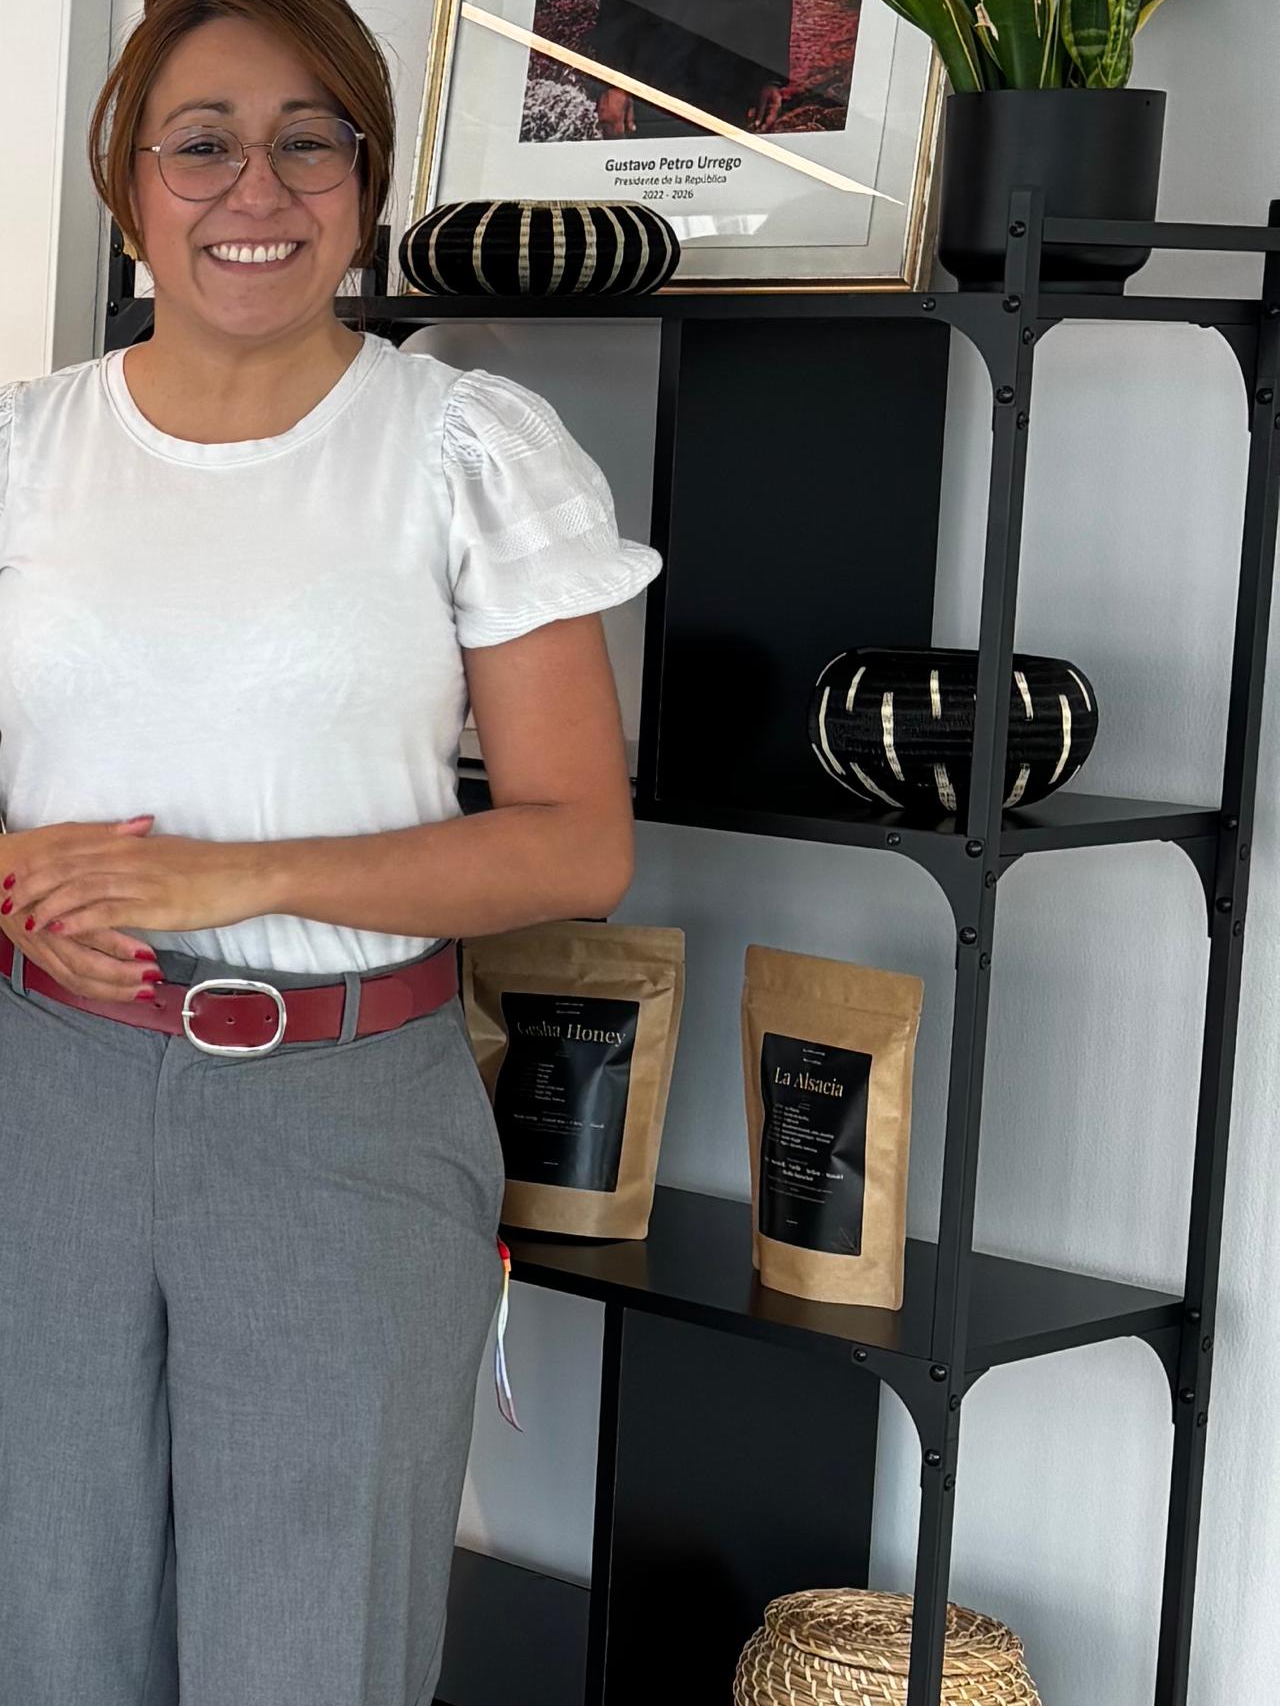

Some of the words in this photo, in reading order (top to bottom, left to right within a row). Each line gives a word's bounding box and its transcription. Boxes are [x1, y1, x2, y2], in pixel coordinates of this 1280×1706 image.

[605, 159, 656, 172] Gustavo
[659, 157, 694, 170] Petro
[697, 156, 742, 171] Urrego
[614, 176, 659, 186] Presidente
[661, 175, 672, 185] de
[674, 175, 682, 185] la
[684, 174, 727, 186] República
[642, 190, 664, 200] 2022
[671, 189, 694, 199] 2026
[566, 1023, 626, 1047] Honey
[774, 1066, 791, 1086] La
[793, 1071, 844, 1098] Alsacia
